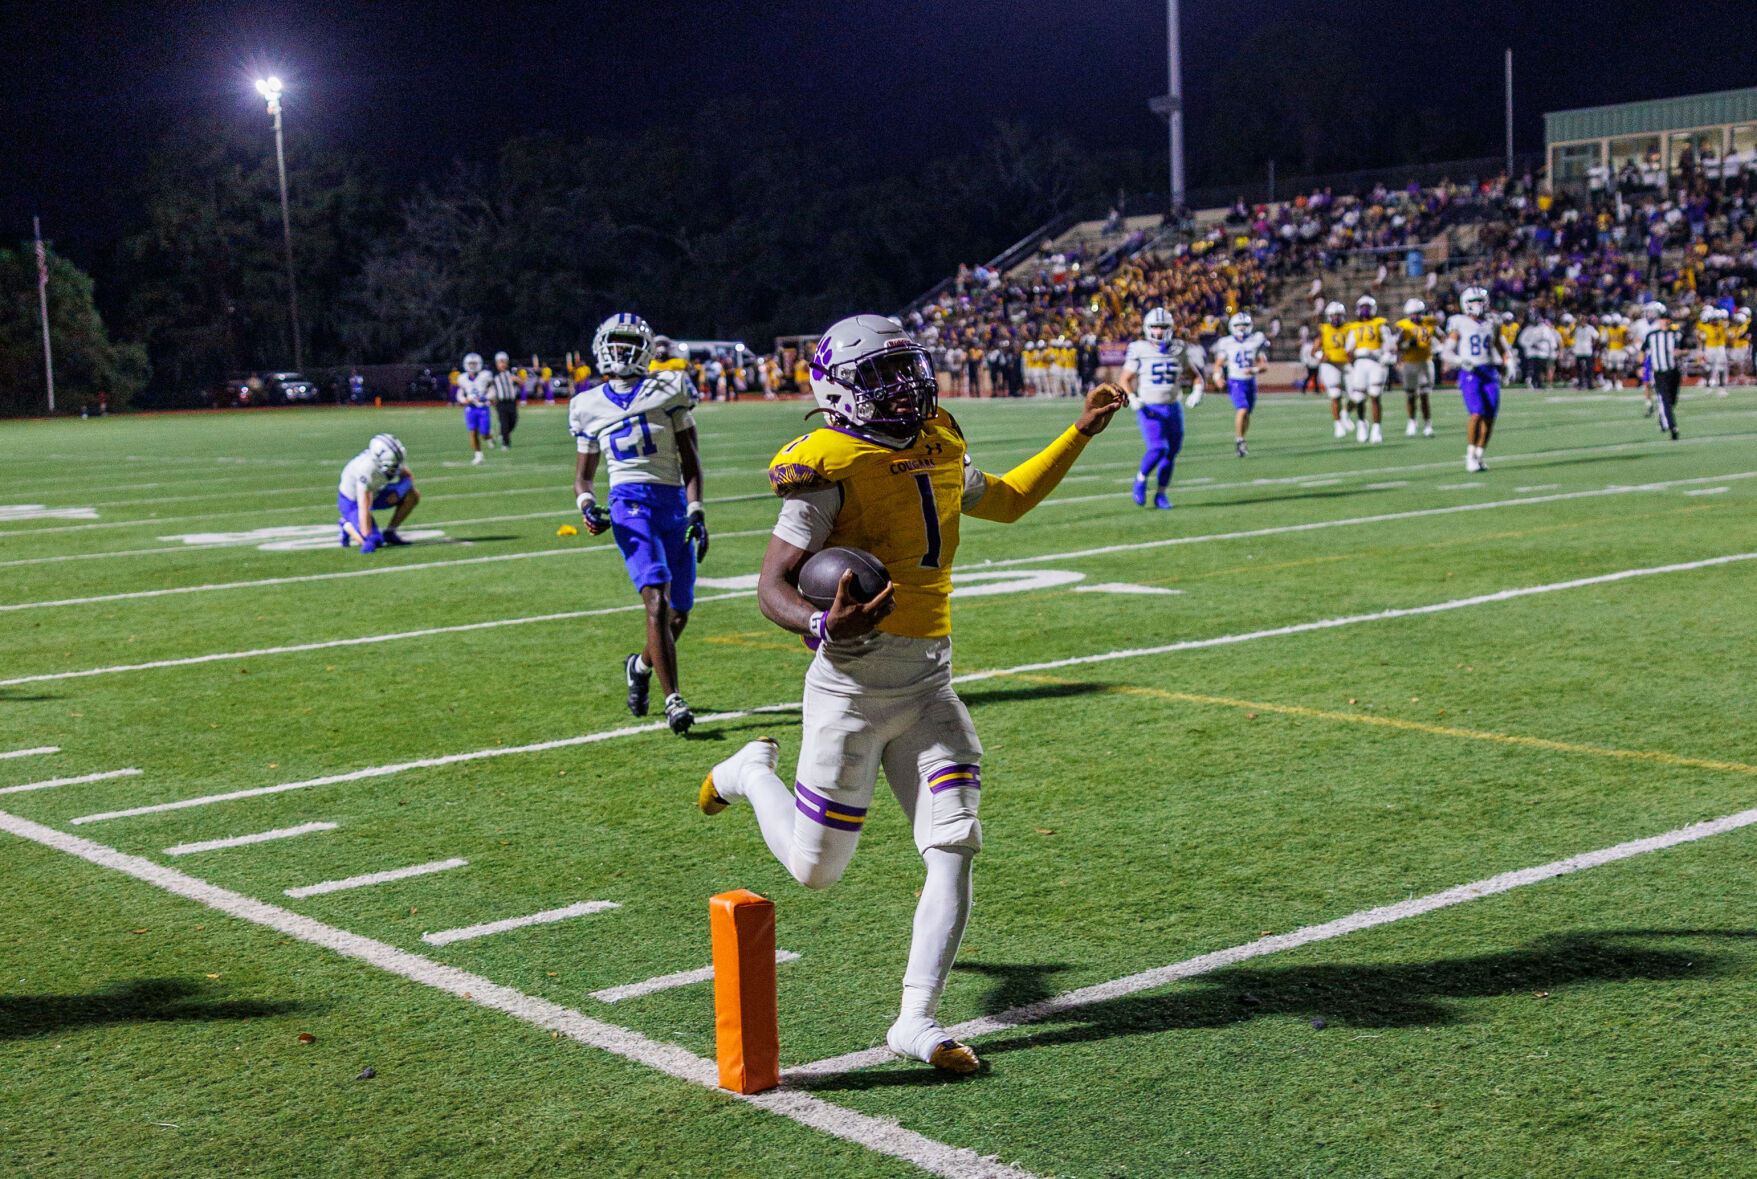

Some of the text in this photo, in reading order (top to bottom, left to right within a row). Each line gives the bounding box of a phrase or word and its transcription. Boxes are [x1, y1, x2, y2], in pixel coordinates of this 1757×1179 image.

[1152, 362, 1178, 384] 55
[609, 412, 658, 461] 21
[909, 472, 942, 569] 1
